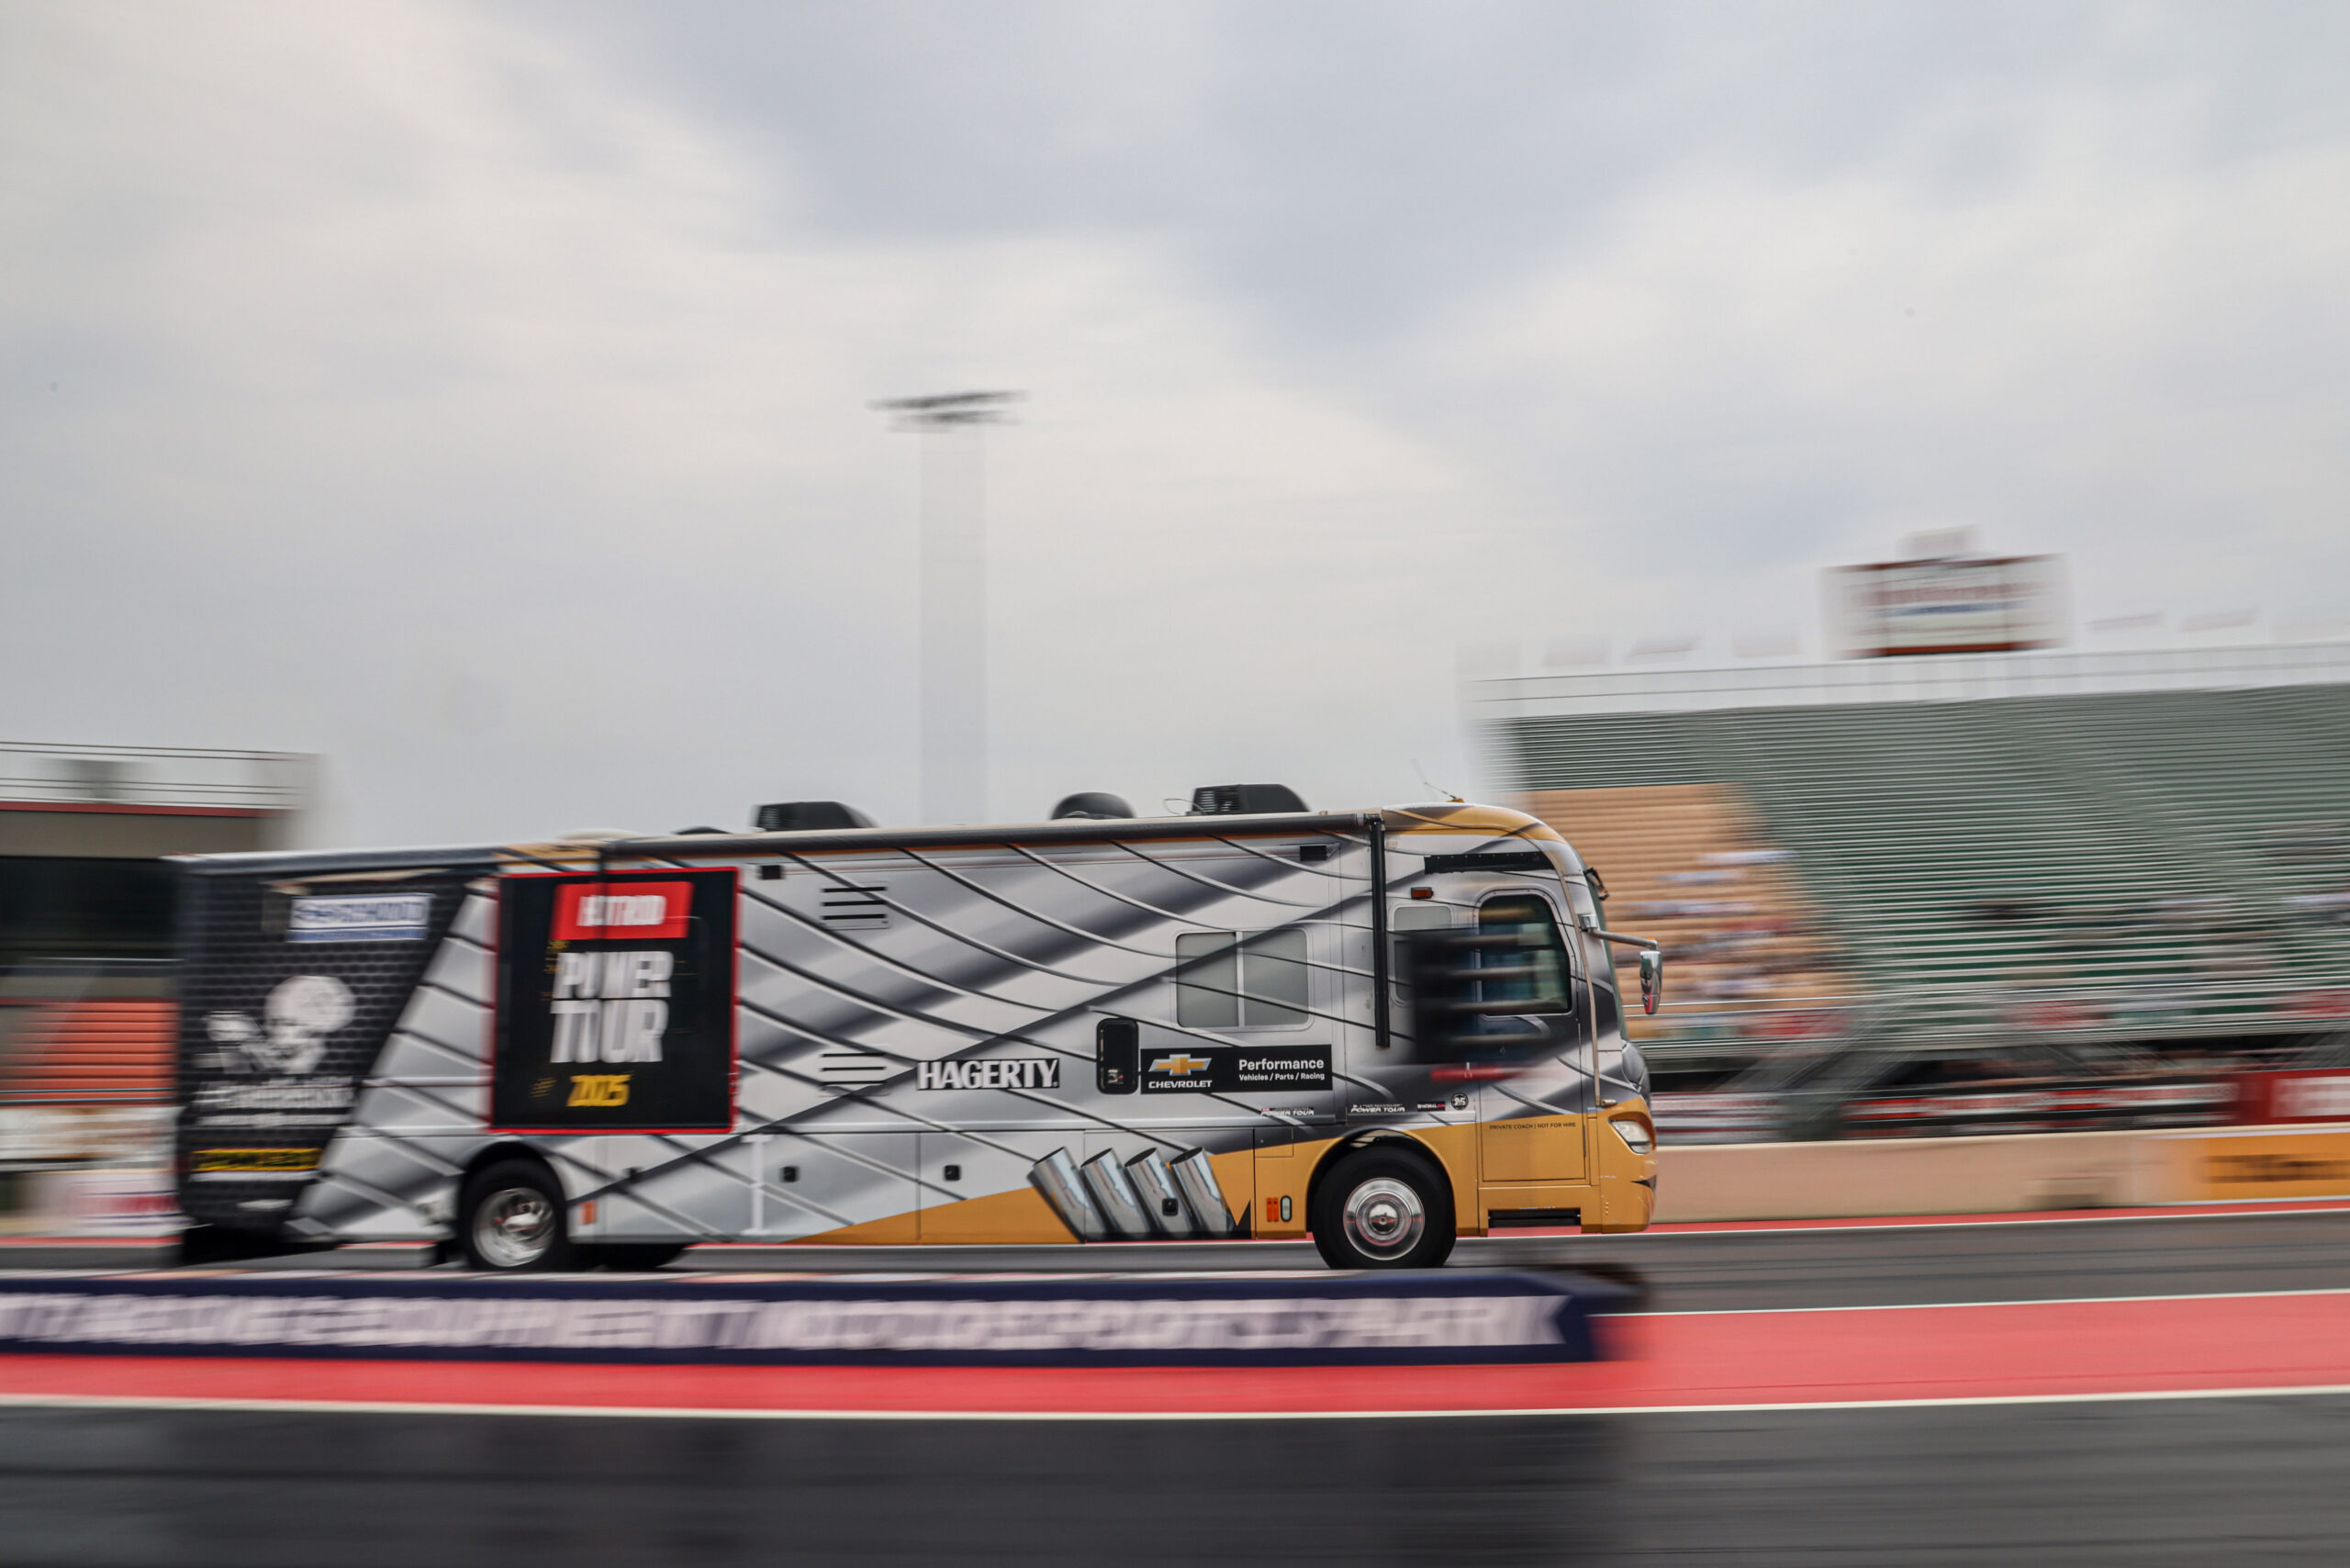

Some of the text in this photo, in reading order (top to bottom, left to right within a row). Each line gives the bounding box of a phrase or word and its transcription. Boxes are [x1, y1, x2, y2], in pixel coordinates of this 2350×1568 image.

[552, 951, 675, 999] POWER
[550, 999, 669, 1064] TOUR
[918, 1059, 1058, 1090] HAGERTY
[1238, 1058, 1325, 1071] Performance
[1148, 1080, 1213, 1089] CHEVROLET
[1238, 1073, 1269, 1081] Vehicles
[1275, 1072, 1294, 1081] Parts
[1301, 1071, 1326, 1081] Racing
